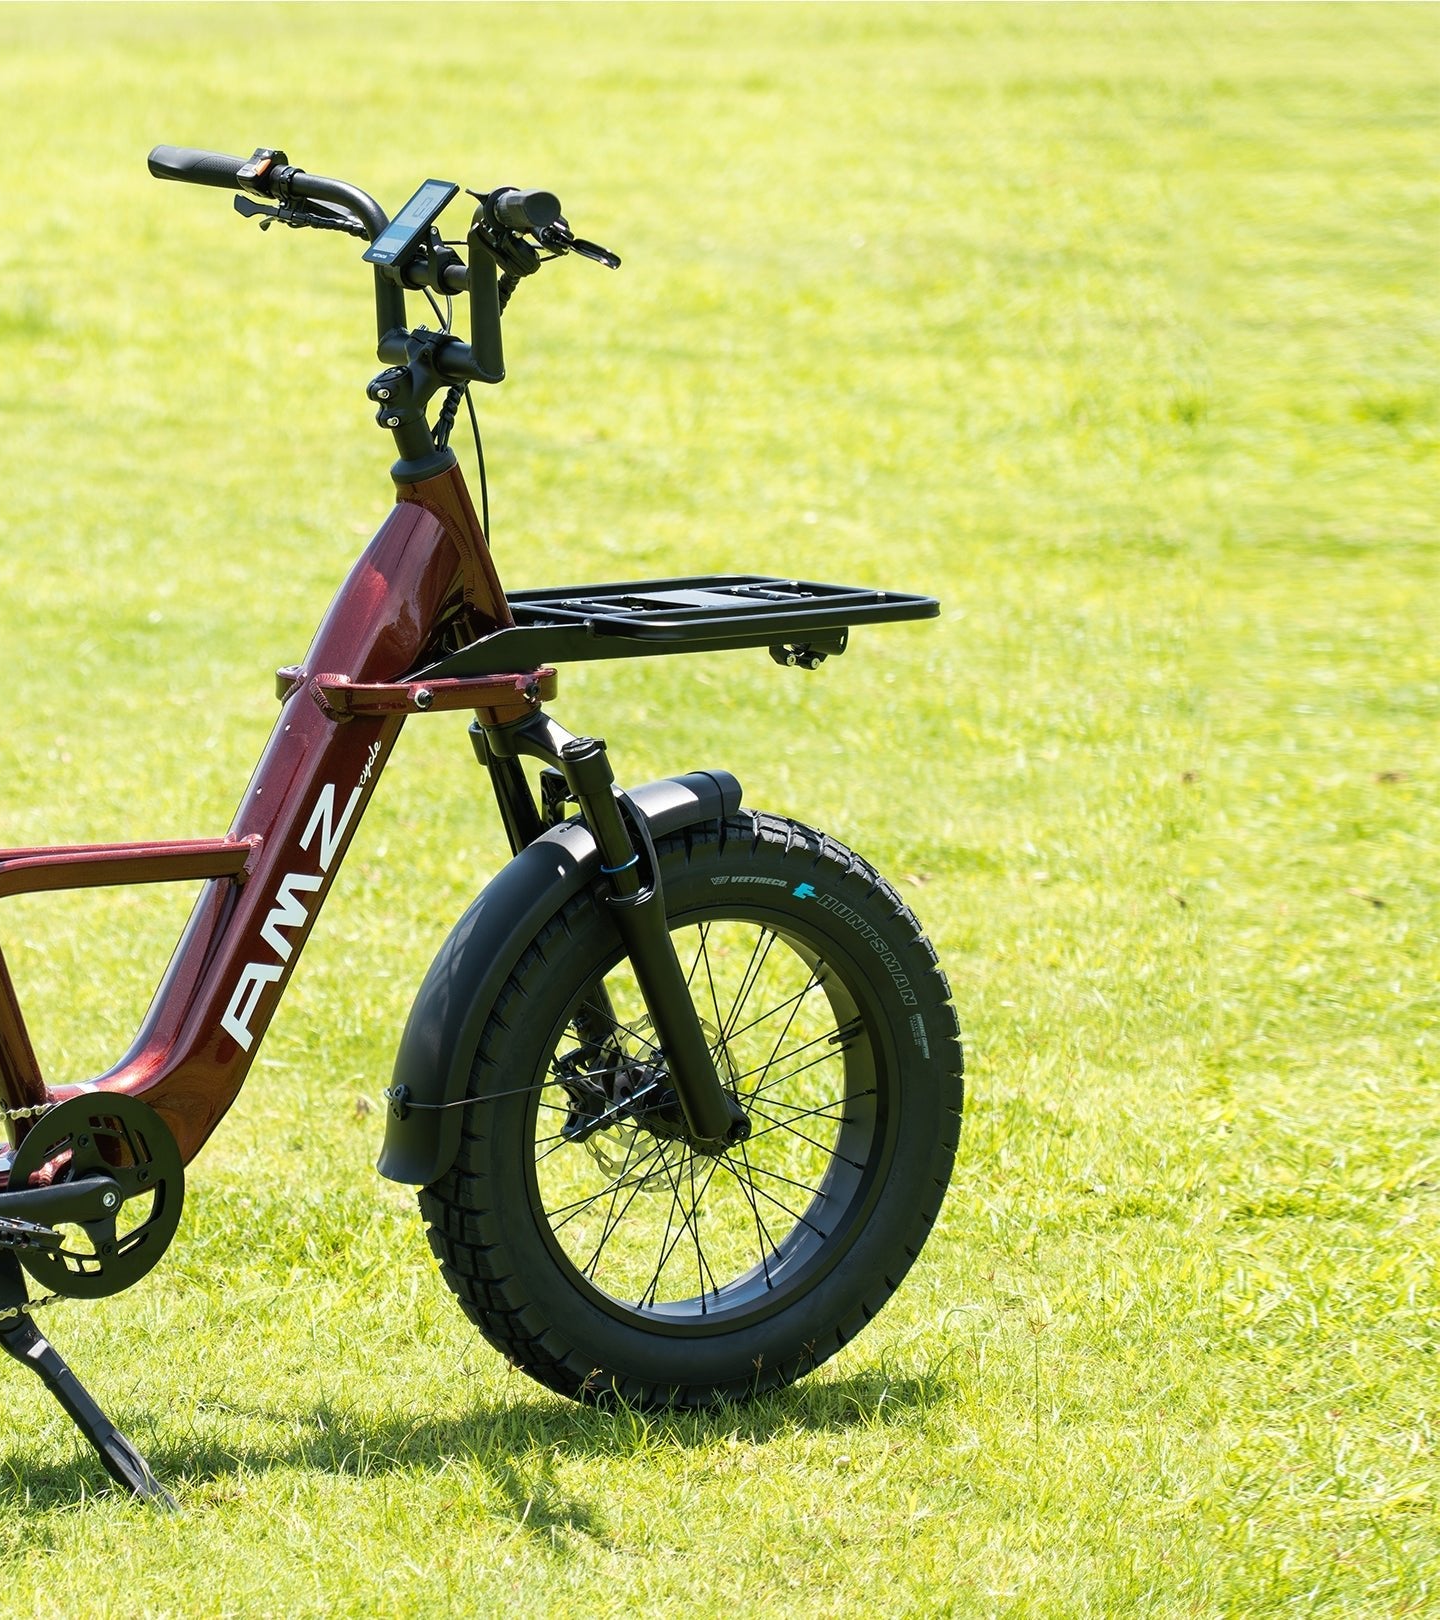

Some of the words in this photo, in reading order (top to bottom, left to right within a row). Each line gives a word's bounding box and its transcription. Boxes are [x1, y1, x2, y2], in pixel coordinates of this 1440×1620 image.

[220, 783, 363, 1052] AMZ
[359, 740, 382, 786] cycle
[816, 893, 918, 1006] HUNTSMAN
